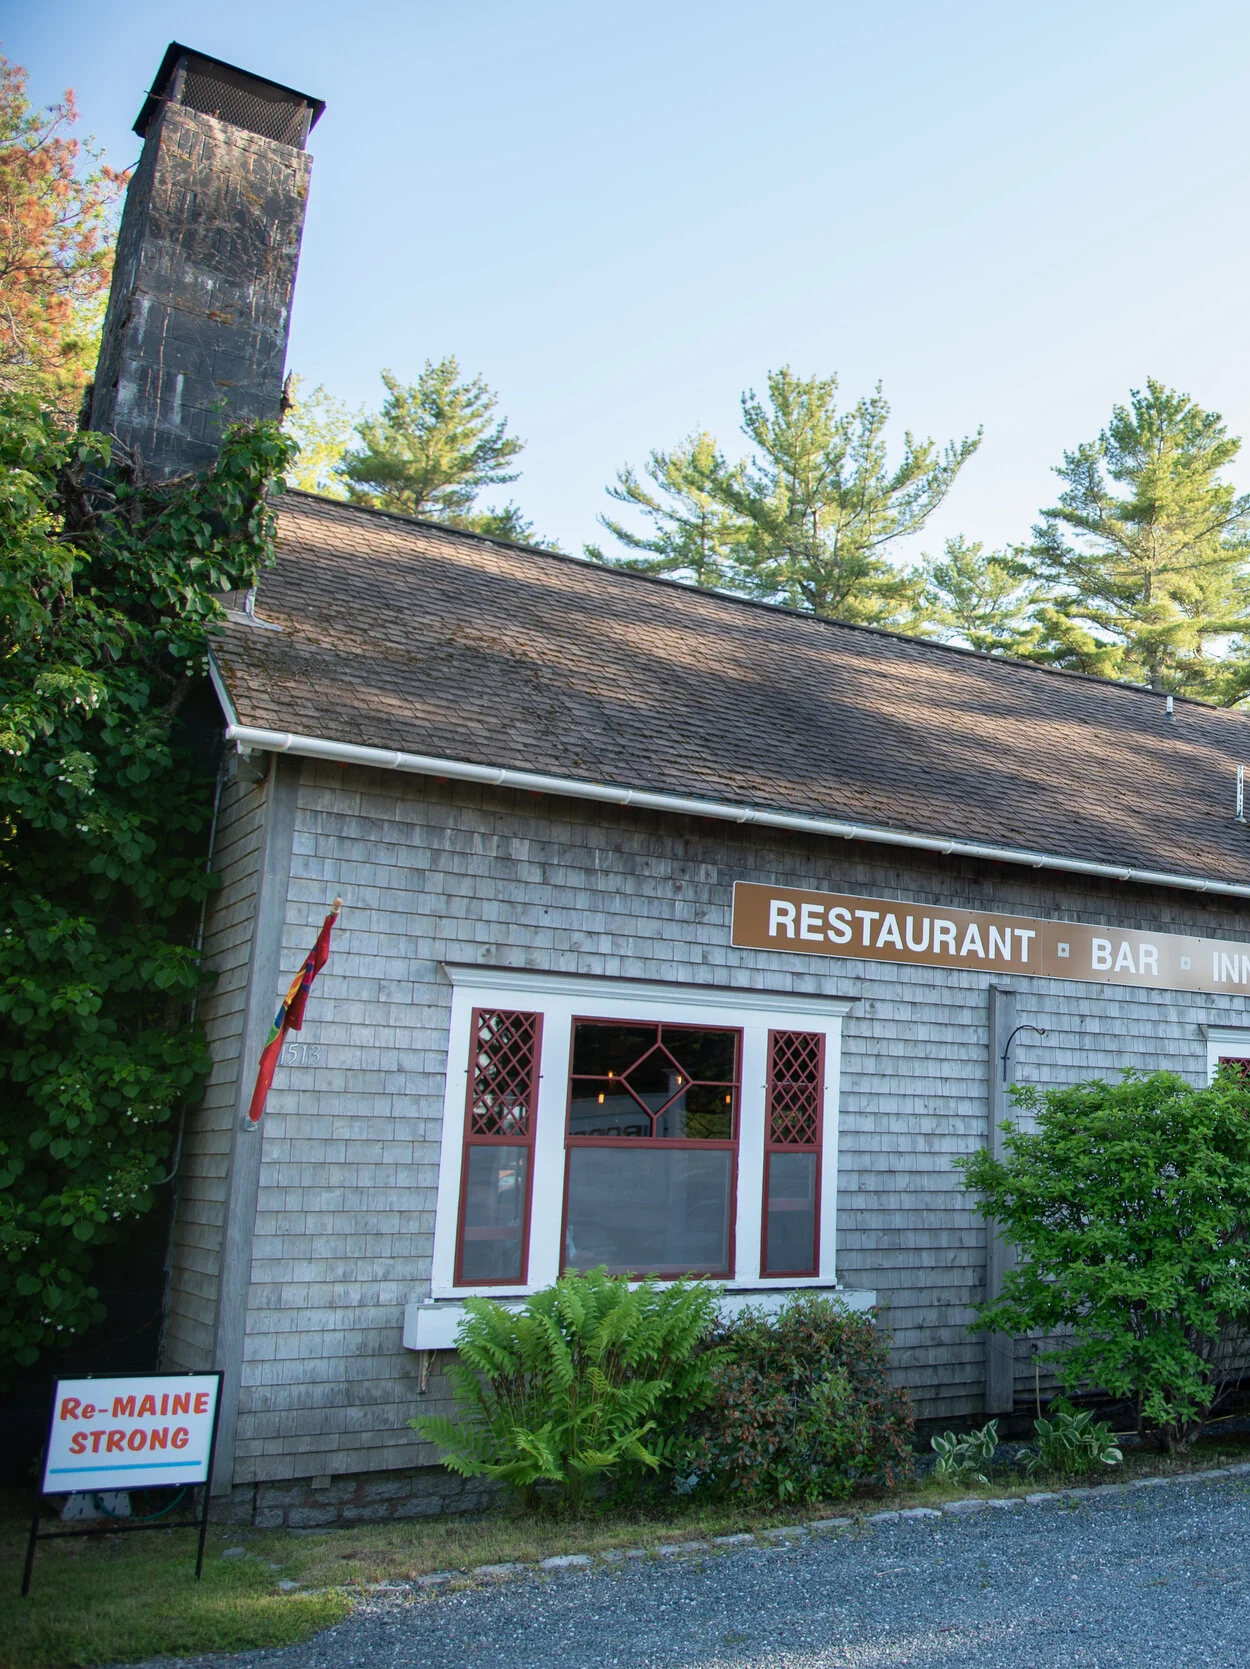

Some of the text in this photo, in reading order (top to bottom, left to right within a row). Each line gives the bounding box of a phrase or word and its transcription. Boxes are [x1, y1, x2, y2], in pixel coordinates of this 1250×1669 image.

[769, 900, 1036, 963] RESTAURANT
[1091, 938, 1159, 976] BAR
[60, 1392, 210, 1421] Re-MAINE
[69, 1427, 190, 1454] STRONG
